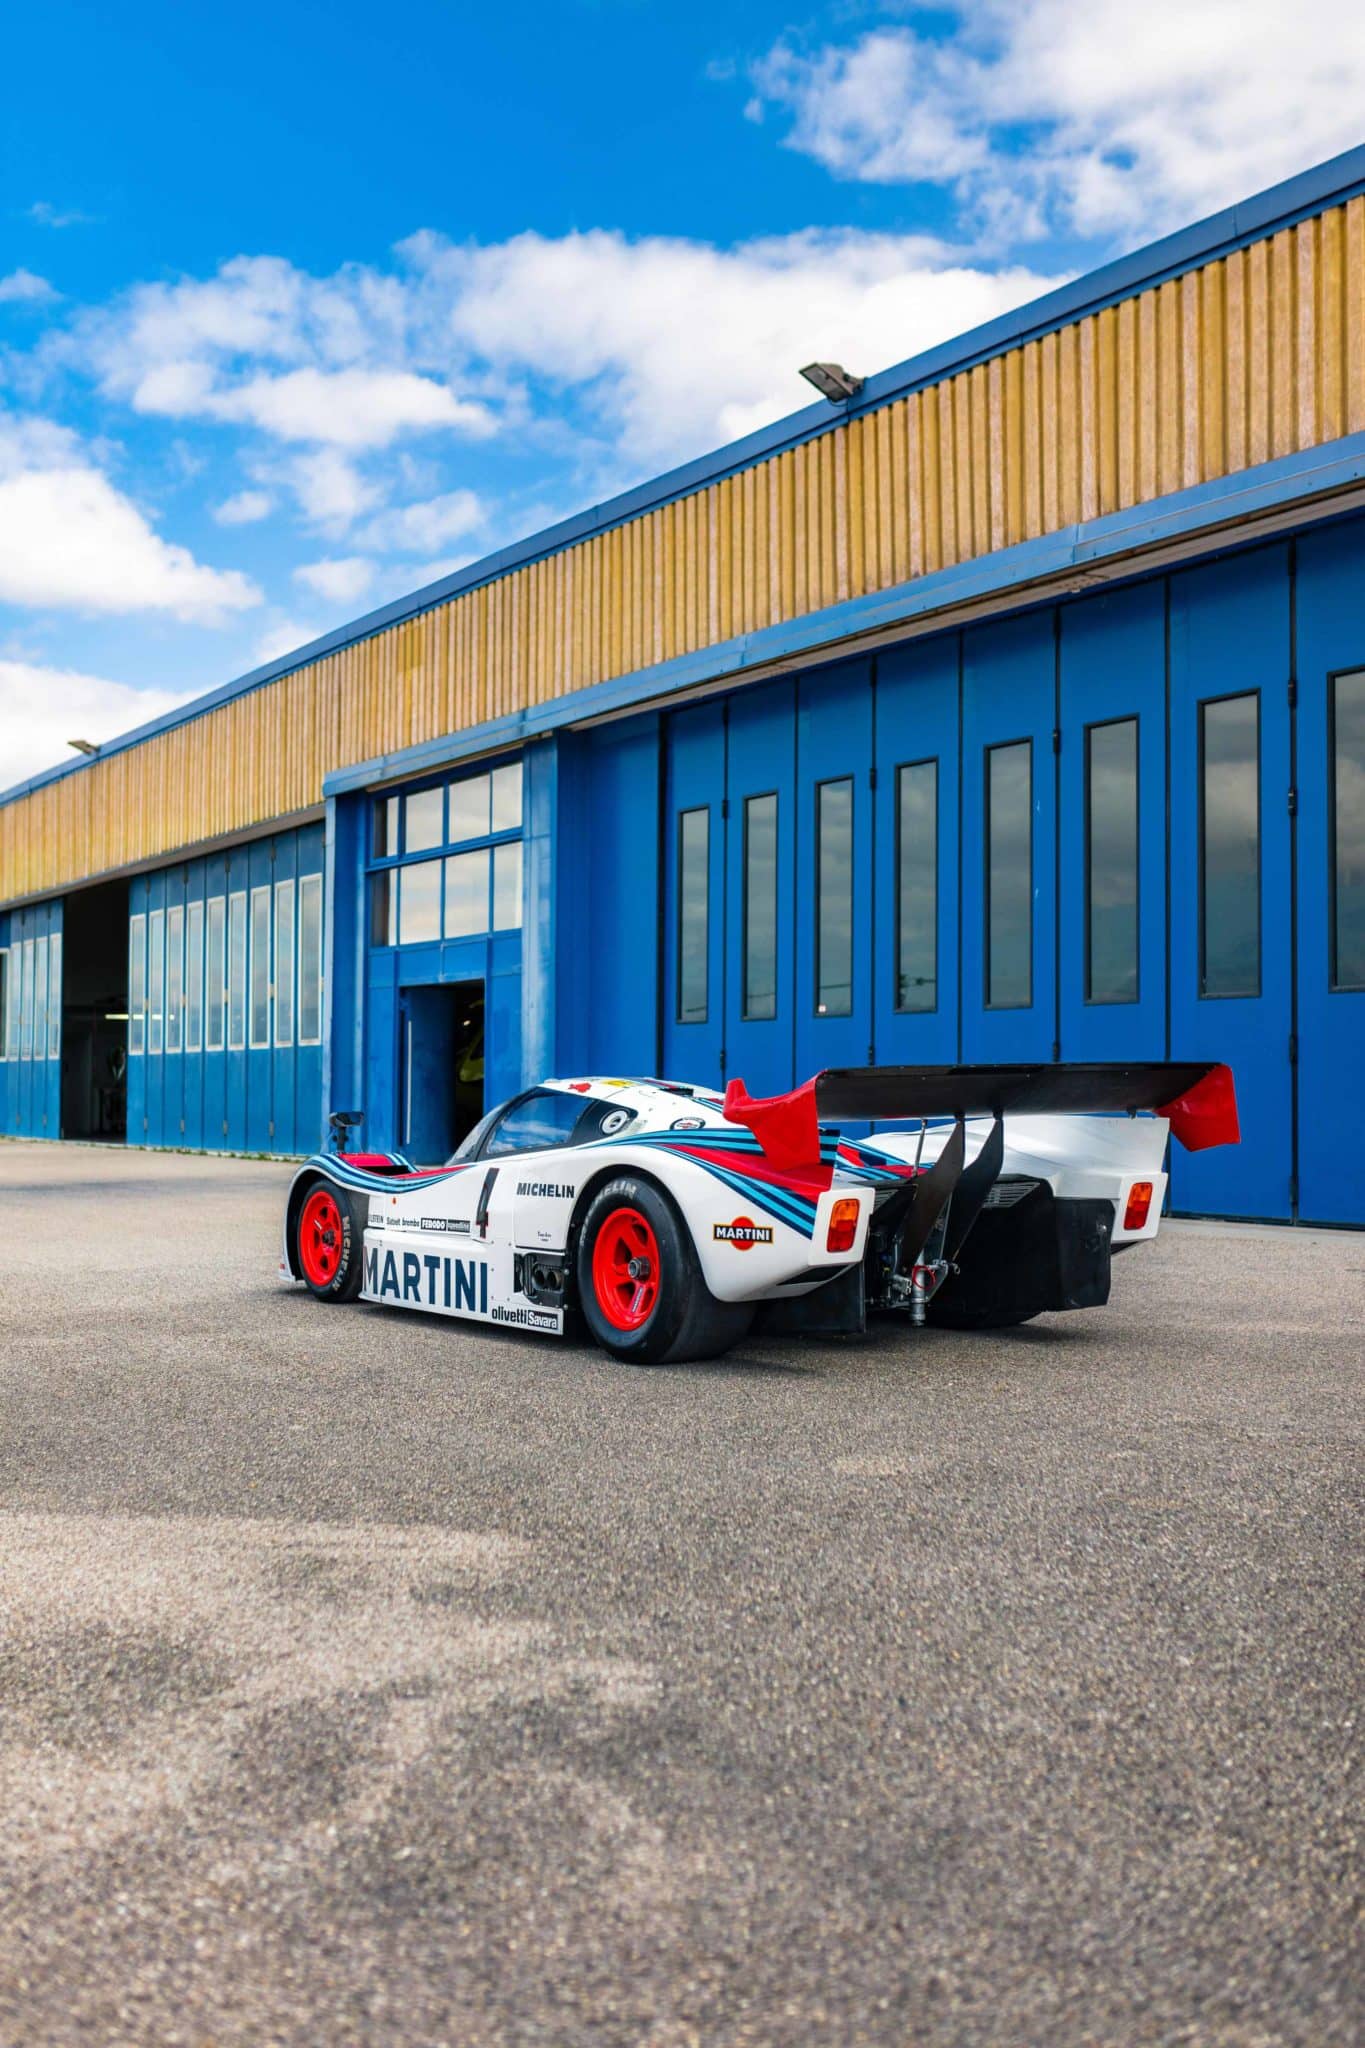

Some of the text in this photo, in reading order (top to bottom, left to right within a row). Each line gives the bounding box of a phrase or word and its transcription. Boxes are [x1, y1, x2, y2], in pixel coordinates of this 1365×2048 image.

[516, 1182, 575, 1198] MICHELIN
[421, 1219, 445, 1229] FERODO
[716, 1226, 770, 1241] MARTINI
[334, 1216, 351, 1291] MICHELIN
[362, 1246, 488, 1314] MARTINI
[491, 1306, 558, 1329] olivetti Savara
